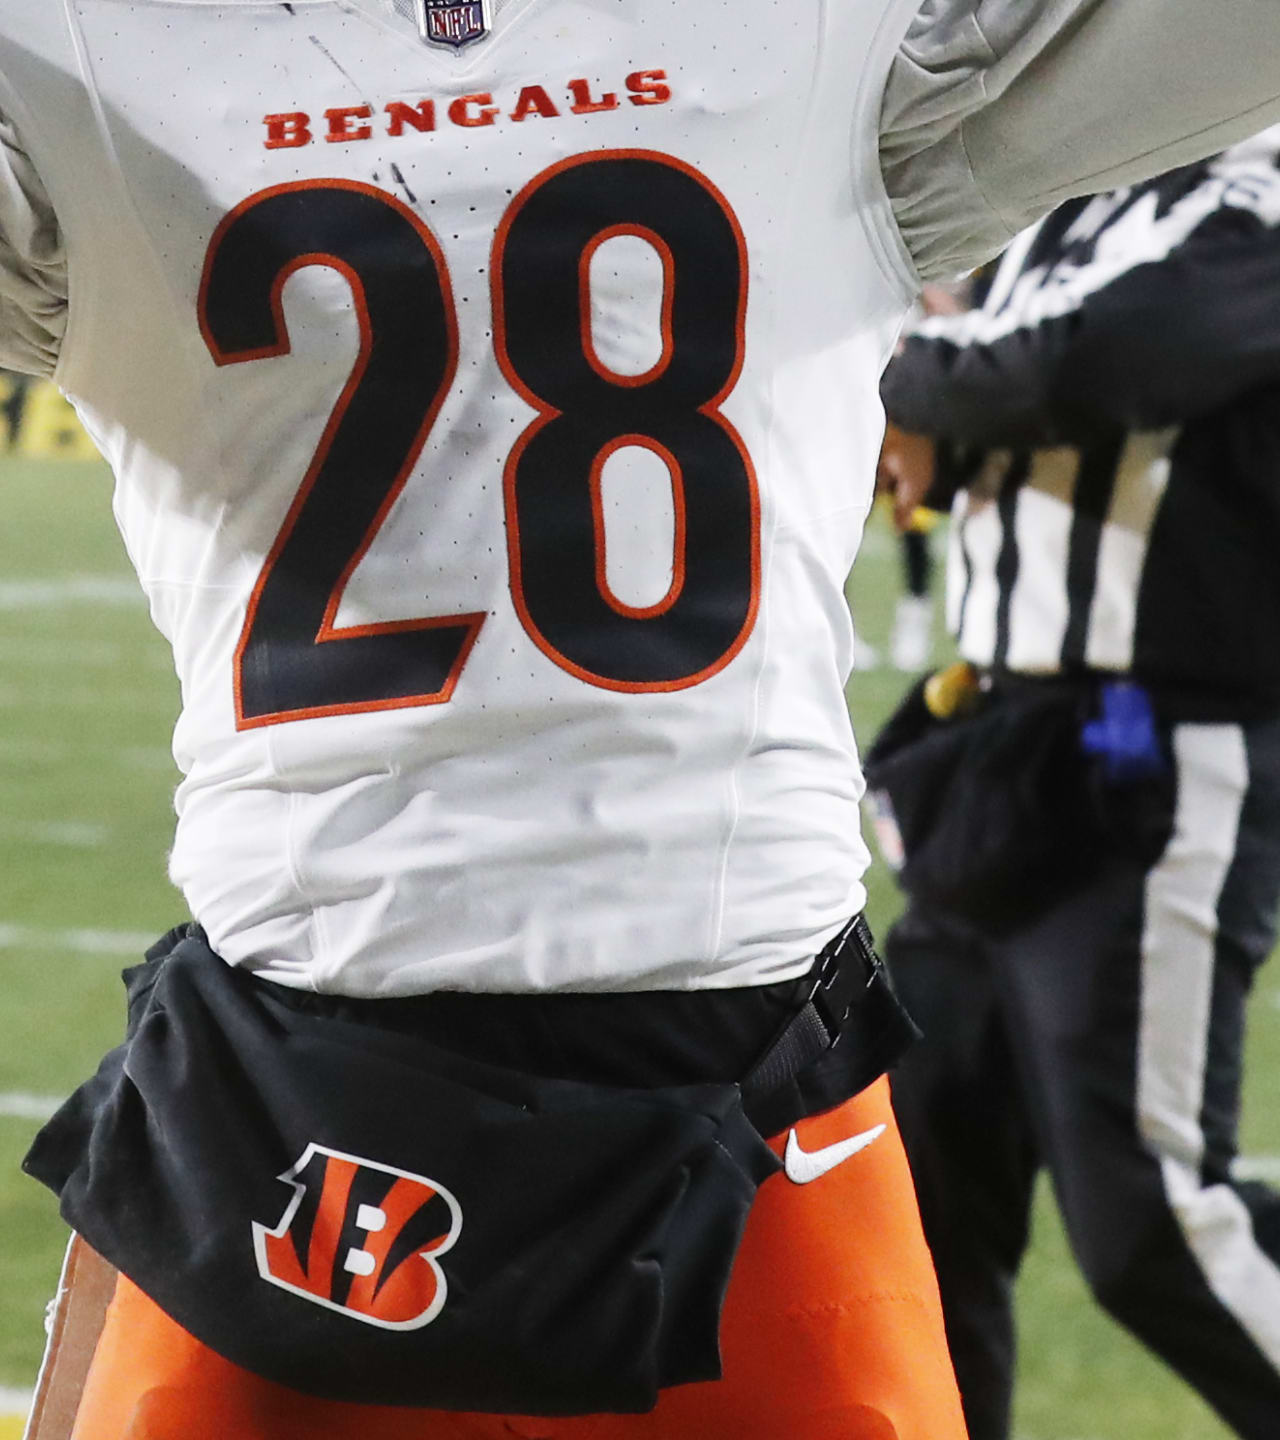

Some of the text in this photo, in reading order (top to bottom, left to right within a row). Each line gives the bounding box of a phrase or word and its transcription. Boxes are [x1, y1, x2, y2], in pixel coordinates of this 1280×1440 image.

[429, 6, 481, 40] NFL
[263, 68, 674, 150] BENGALS
[196, 148, 762, 731] 28
